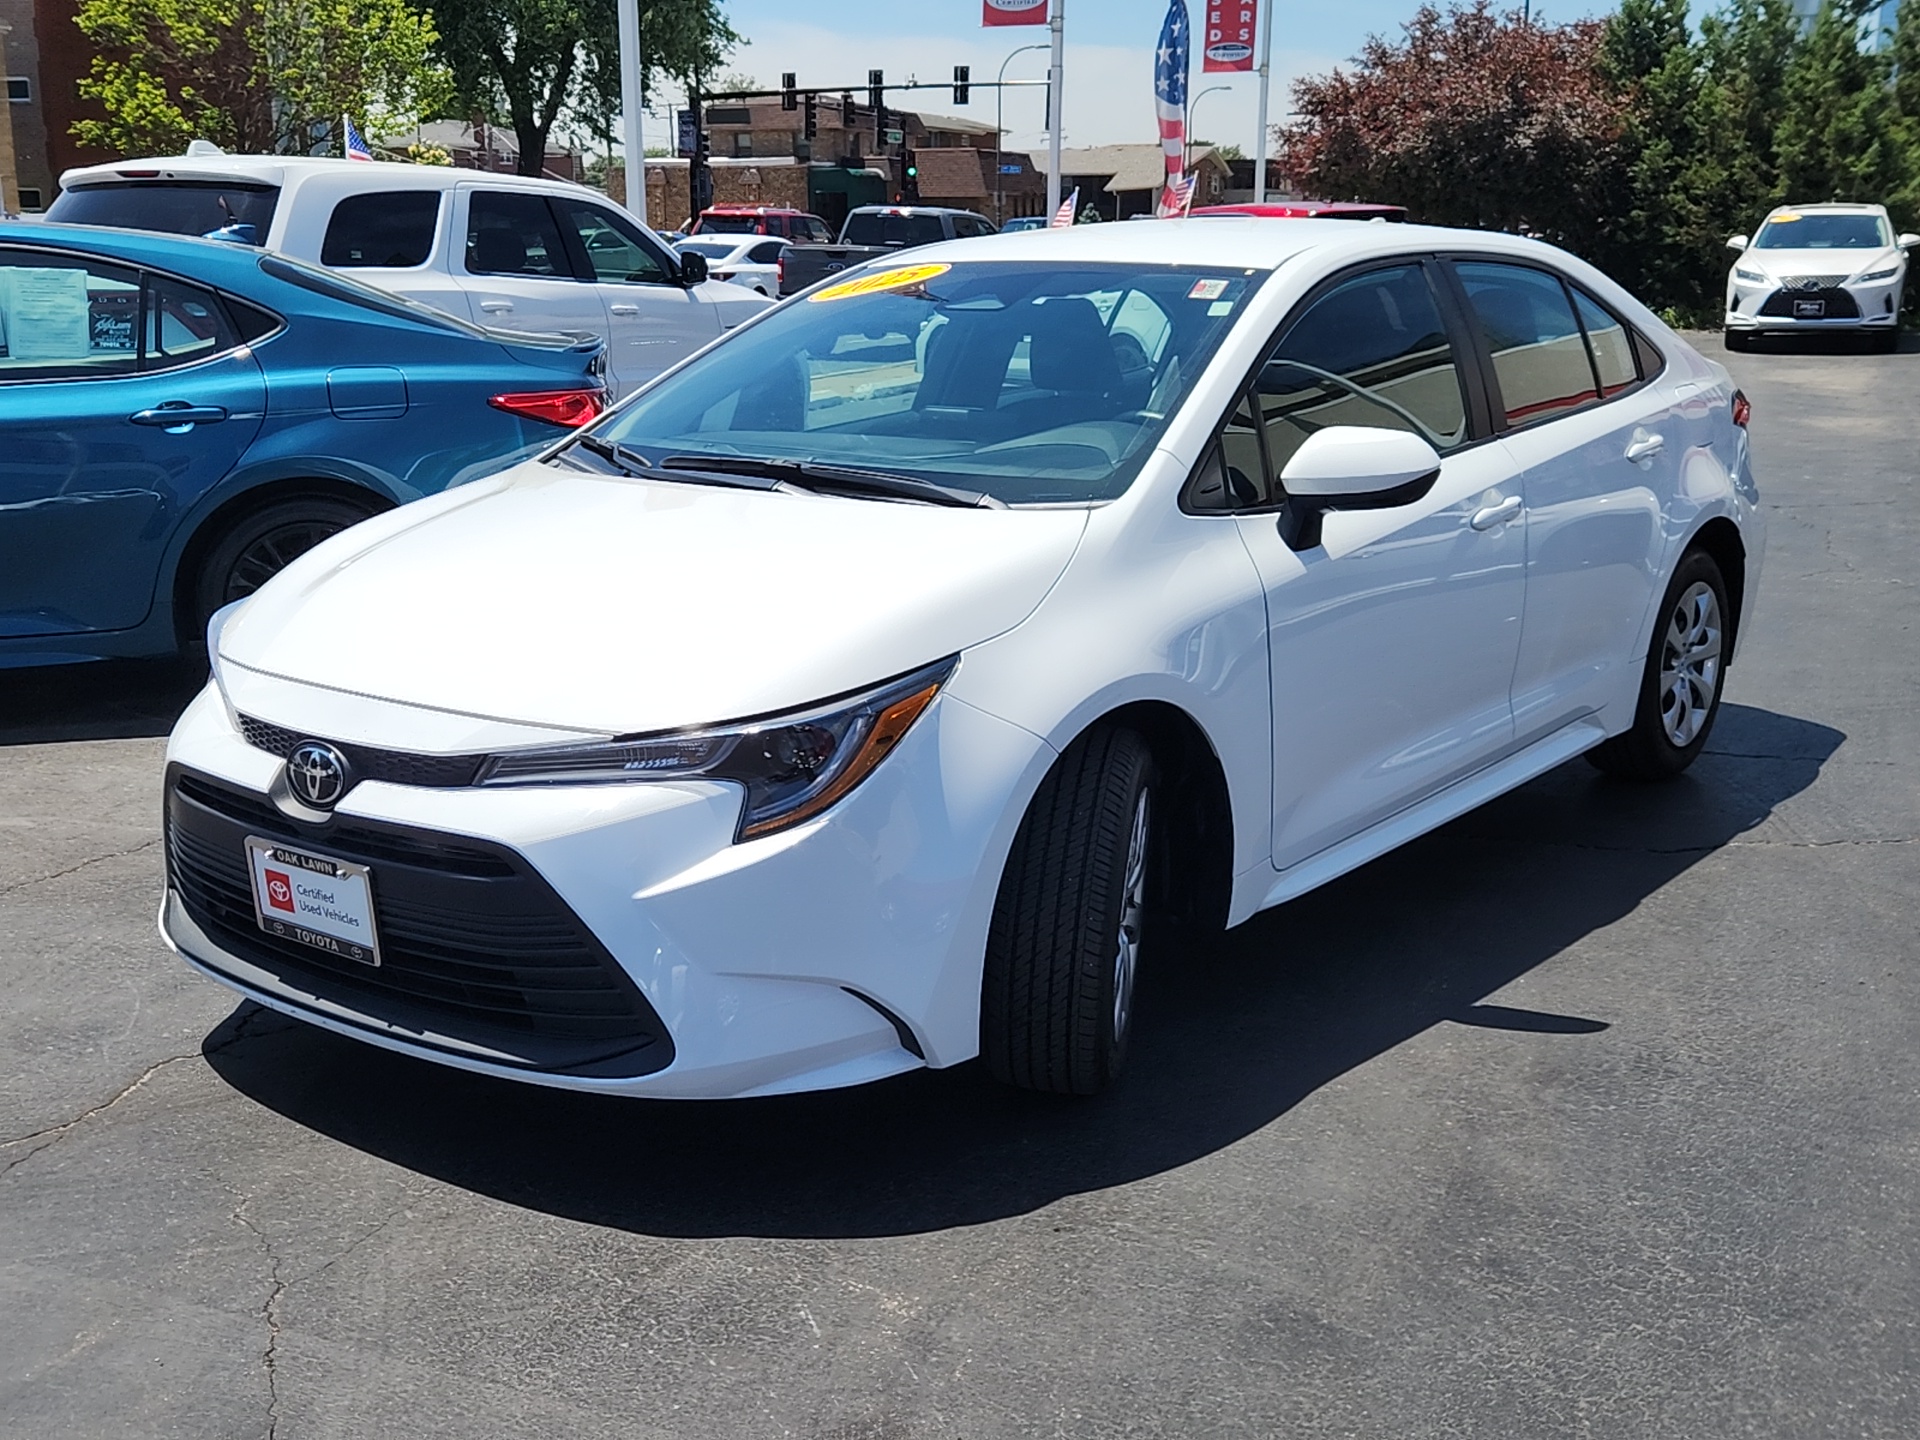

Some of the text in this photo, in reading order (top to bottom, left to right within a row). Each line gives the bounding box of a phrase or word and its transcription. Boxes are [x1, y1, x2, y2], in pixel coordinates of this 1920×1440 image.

[277, 850, 333, 875] OAK LAWN
[296, 884, 335, 904] Certified
[299, 900, 360, 927] Used Vehicles
[295, 928, 340, 951] TOYOTA
